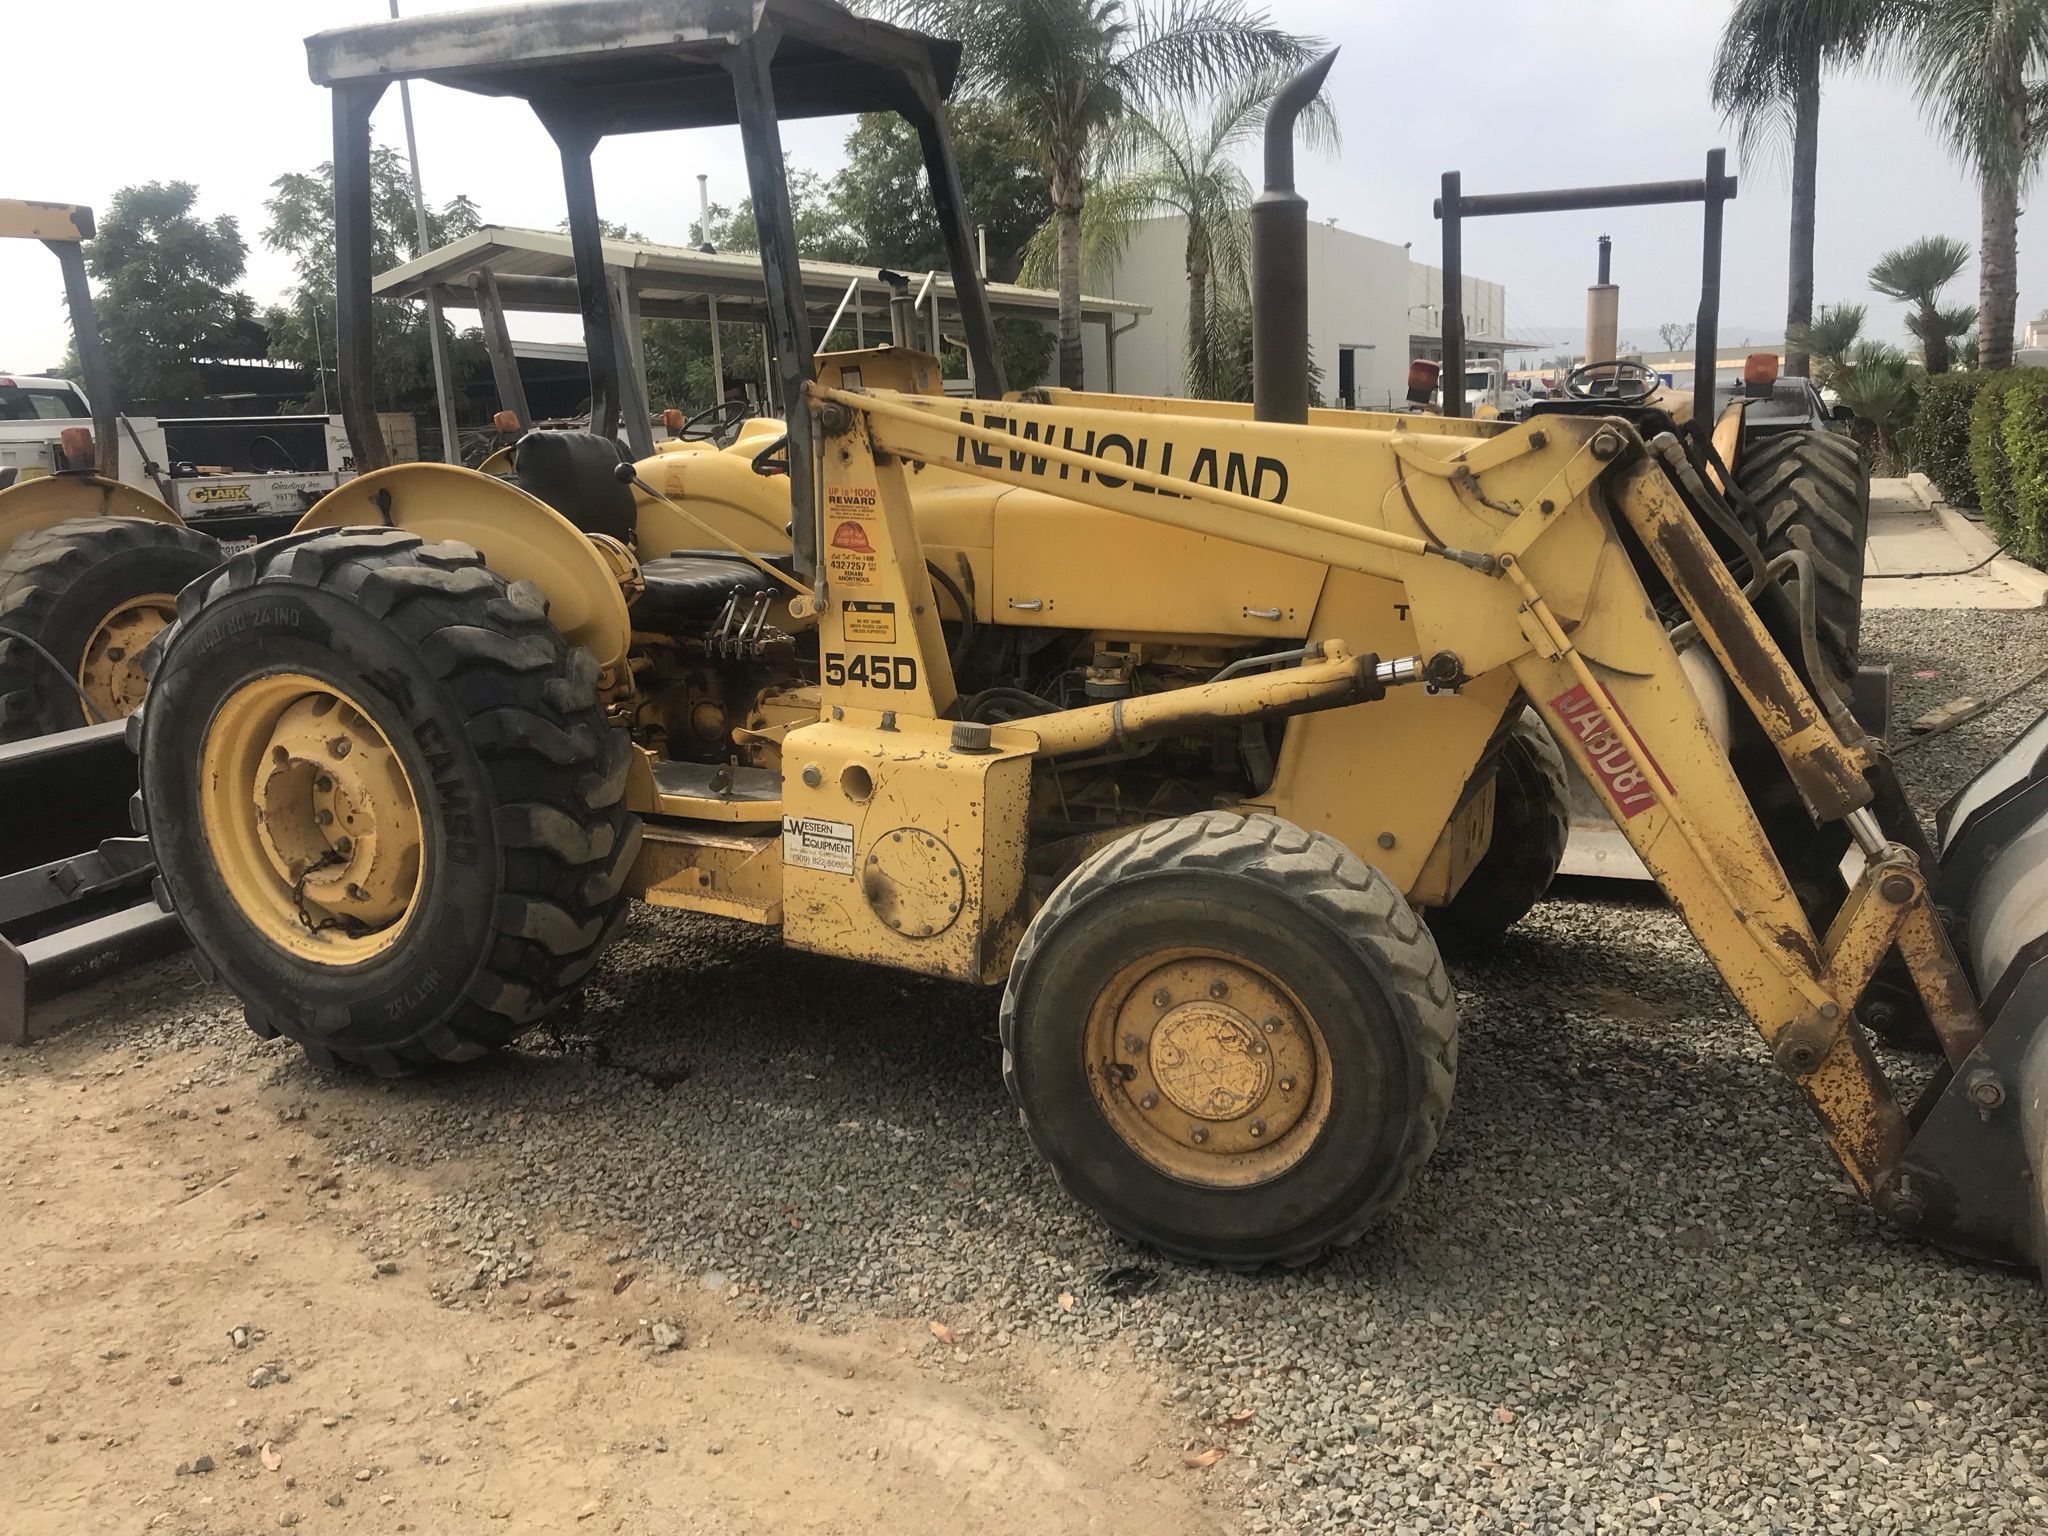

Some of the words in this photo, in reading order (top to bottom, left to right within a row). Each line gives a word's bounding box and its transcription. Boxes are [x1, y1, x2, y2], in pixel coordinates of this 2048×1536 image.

[187, 485, 252, 504] CLARK
[828, 496, 876, 506] REWARD
[825, 652, 917, 690] 545D
[789, 819, 833, 837] WESTERN
[802, 831, 851, 854] EQUIPMENT
